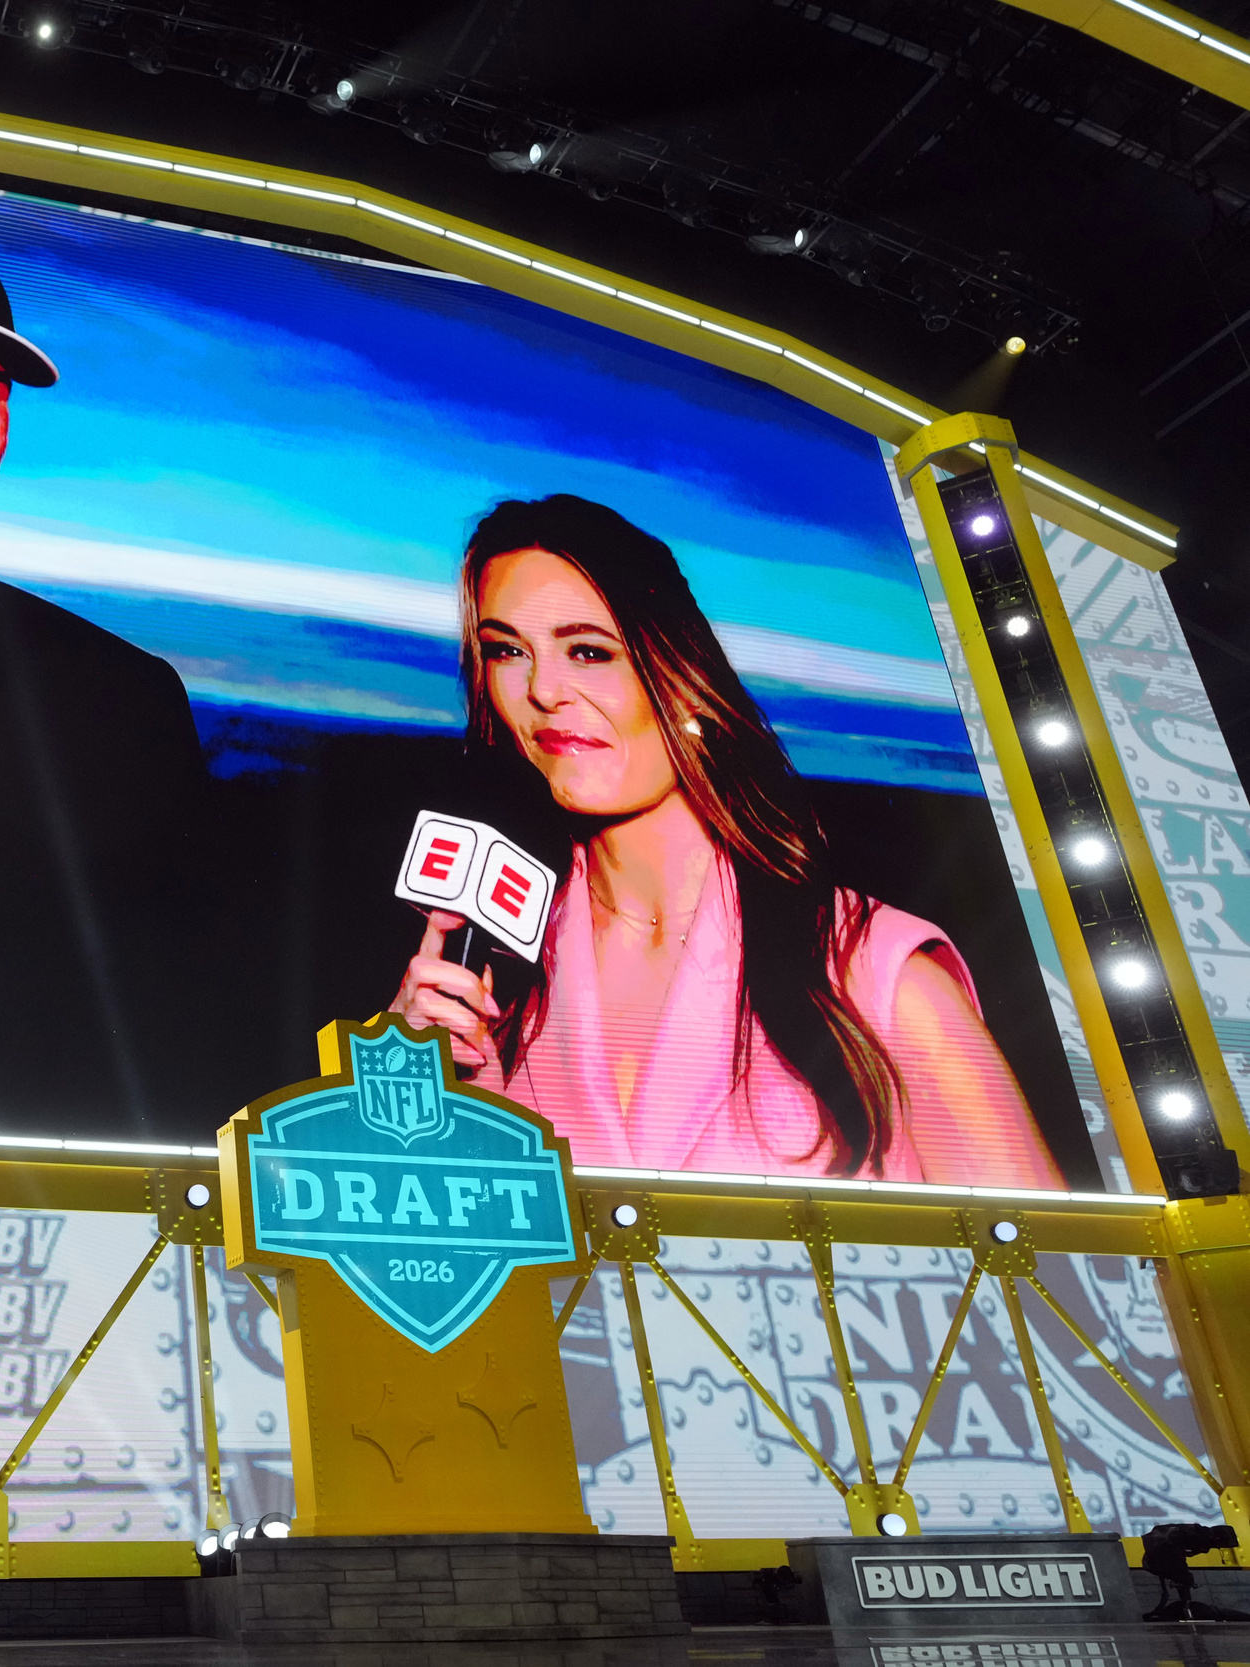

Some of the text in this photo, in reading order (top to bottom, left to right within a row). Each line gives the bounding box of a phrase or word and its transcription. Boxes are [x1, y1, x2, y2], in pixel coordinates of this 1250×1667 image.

[420, 837, 460, 881] E
[490, 863, 532, 919] E
[366, 1078, 435, 1130] NFL
[279, 1168, 538, 1230] DRAFT
[388, 1258, 455, 1283] 2026
[862, 1563, 1087, 1599] BUD LIGHT
